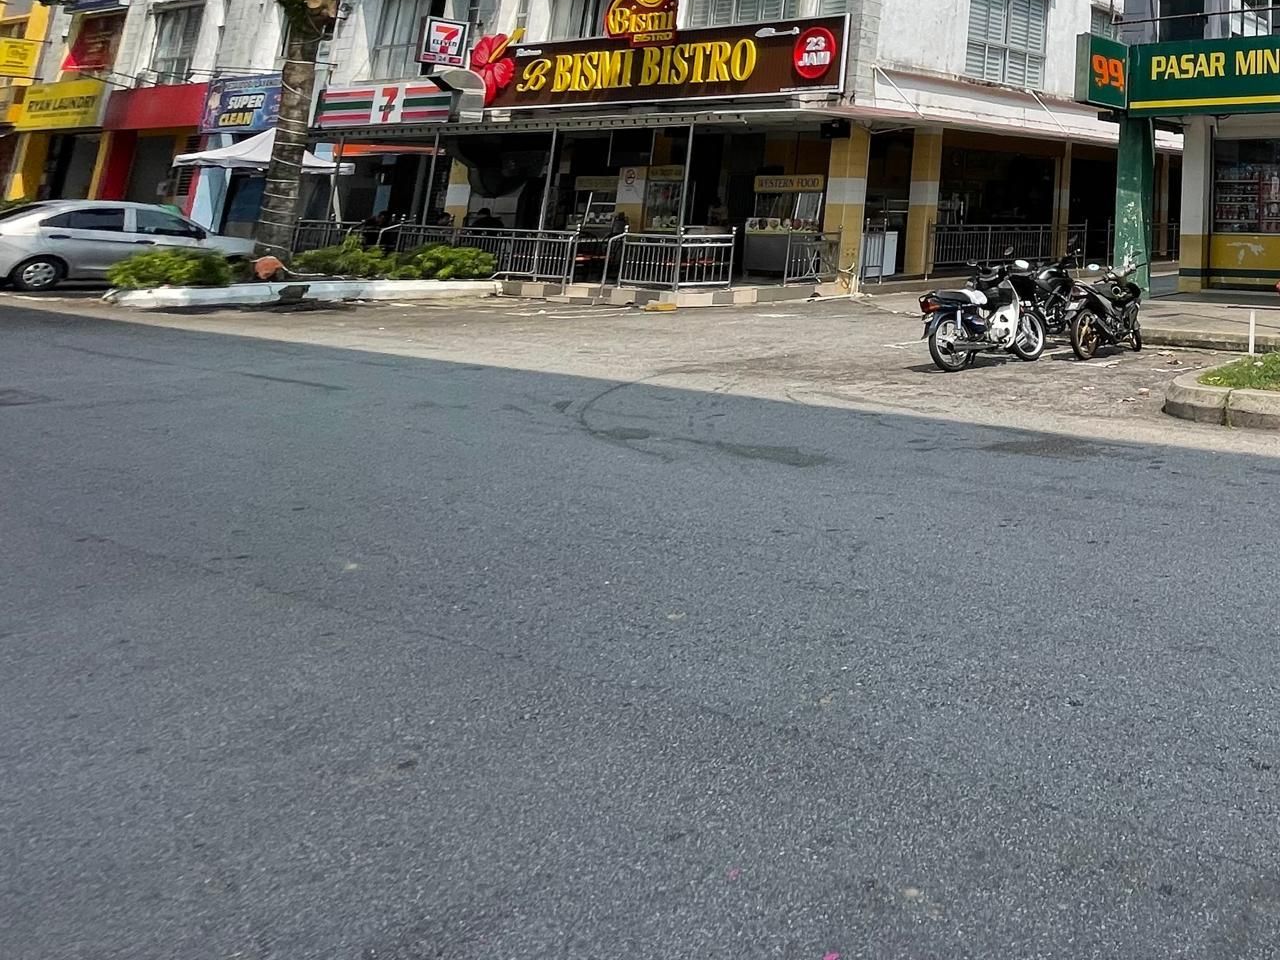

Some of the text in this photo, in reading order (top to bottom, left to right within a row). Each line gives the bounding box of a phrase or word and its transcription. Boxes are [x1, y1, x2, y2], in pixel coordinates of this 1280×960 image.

[608, 5, 674, 34] Bismi
[436, 25, 460, 54] 7
[633, 31, 673, 43] BISTRO
[805, 36, 826, 51] 23
[551, 49, 636, 92] BISMI
[638, 39, 757, 87] BISTRO
[797, 51, 831, 67] JAM
[1092, 54, 1126, 92] 99
[1151, 52, 1226, 81] PASAR
[227, 94, 264, 110] SUPER
[381, 87, 399, 122] 7
[219, 112, 254, 127] CLEAN
